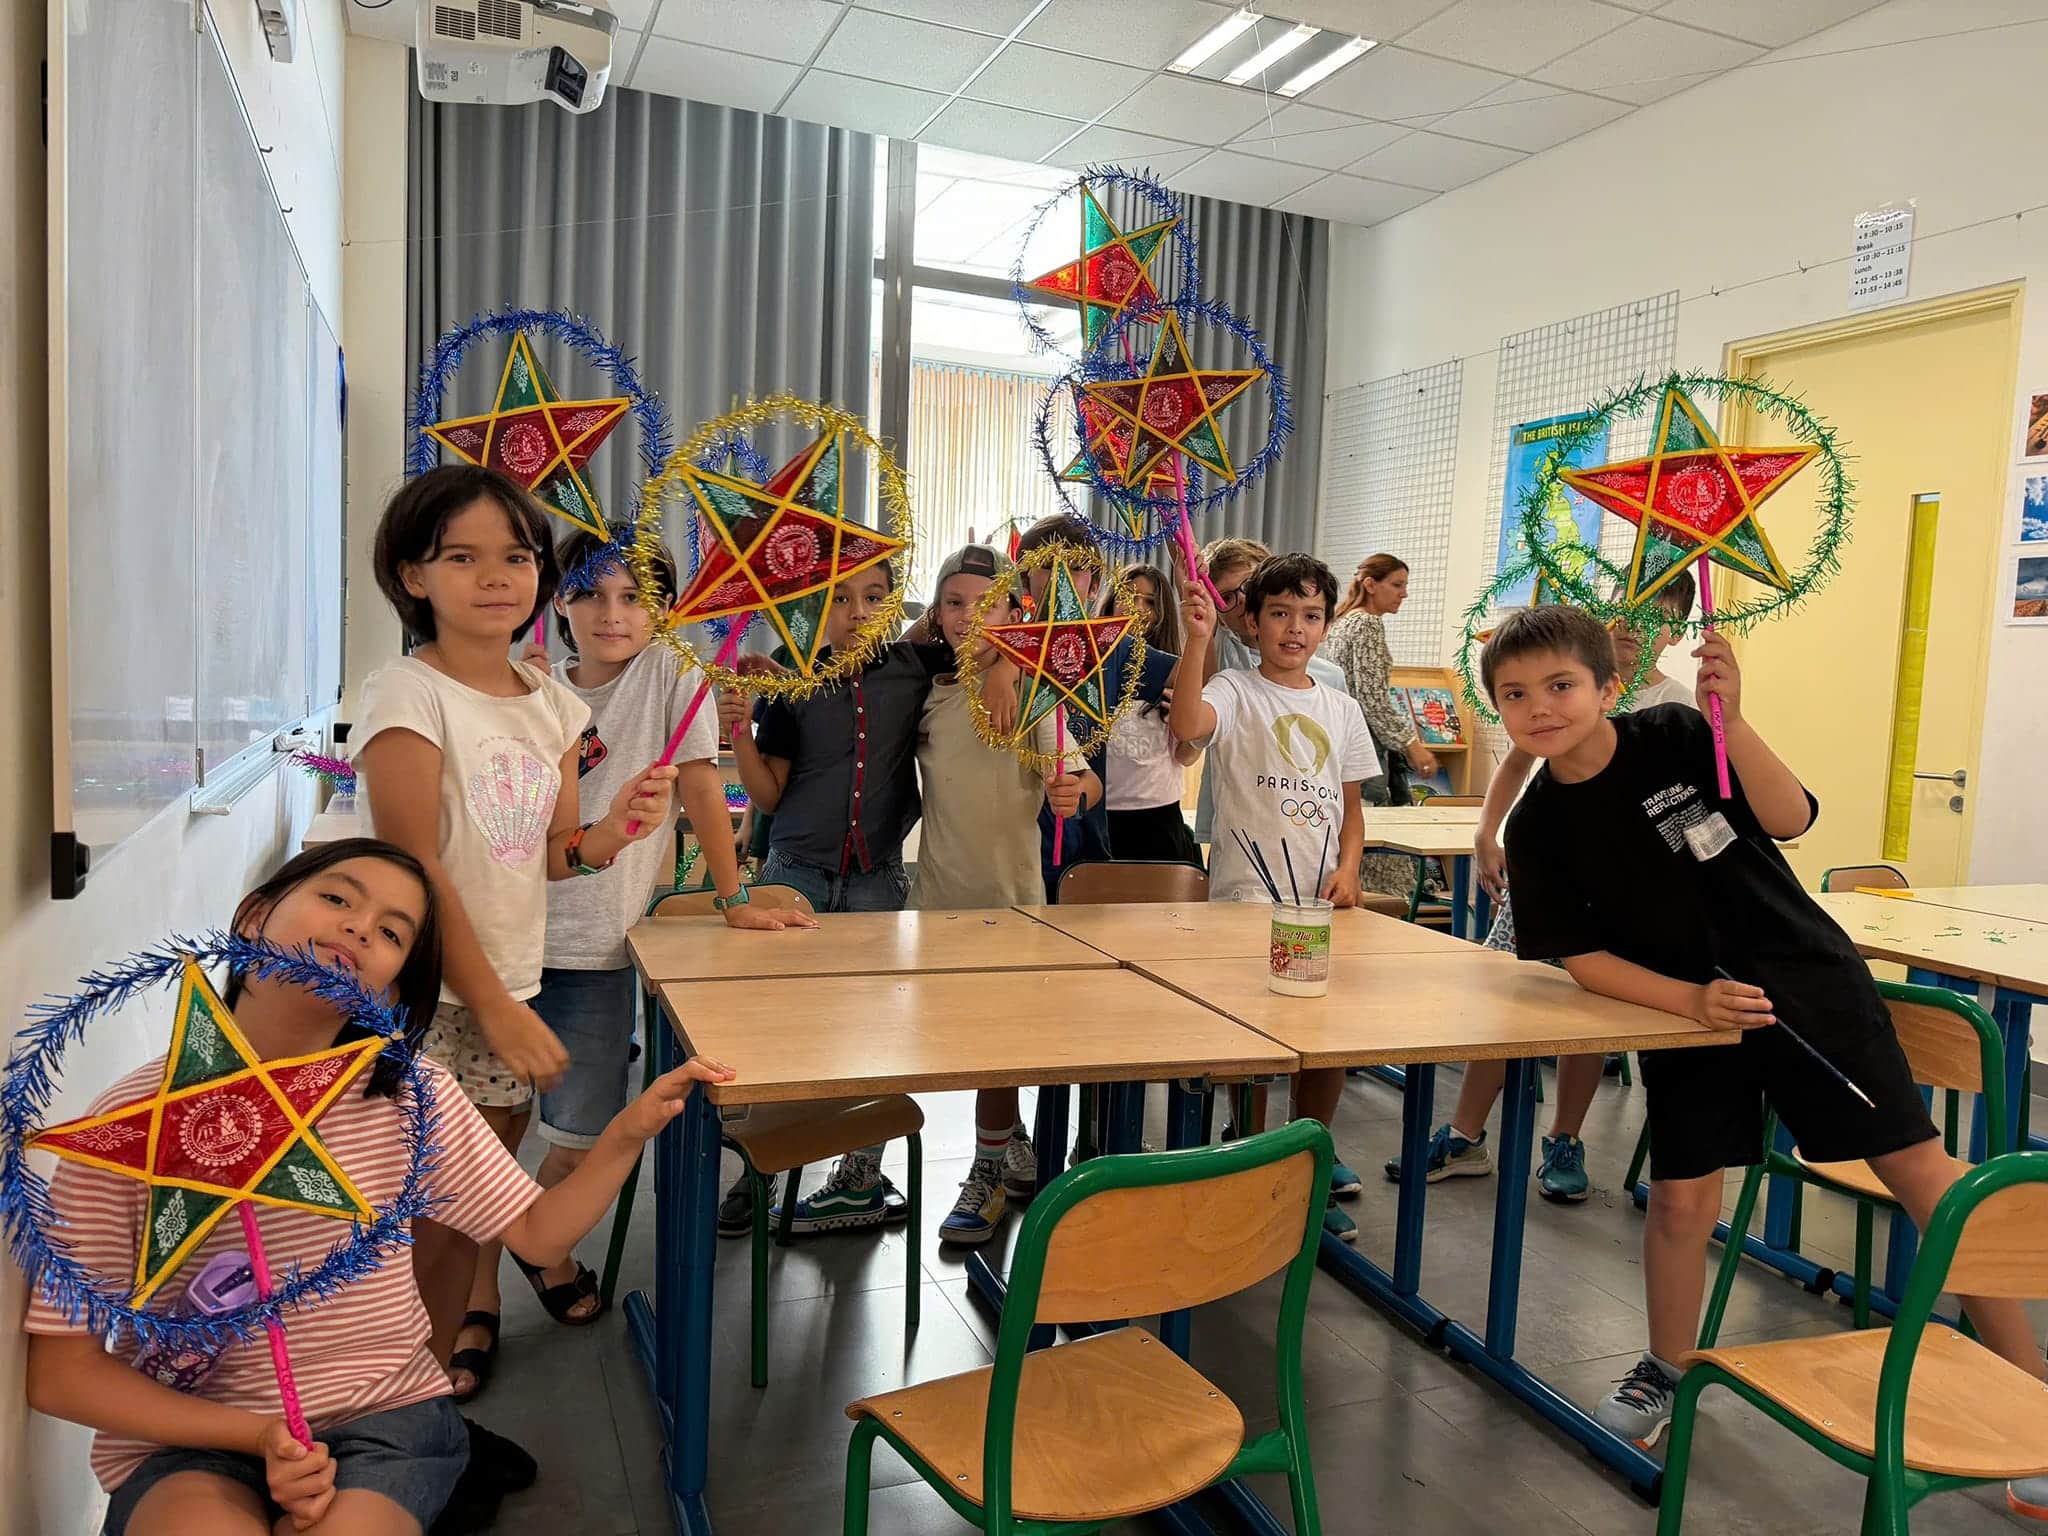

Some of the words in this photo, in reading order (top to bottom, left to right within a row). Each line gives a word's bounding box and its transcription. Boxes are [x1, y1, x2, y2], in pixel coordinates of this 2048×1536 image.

[1857, 242, 1873, 252] Break
[1855, 265, 1872, 275] Lunch
[1523, 431, 1536, 442] THE
[1538, 424, 1566, 440] BRITISH
[1641, 783, 1684, 809] TRAVELING
